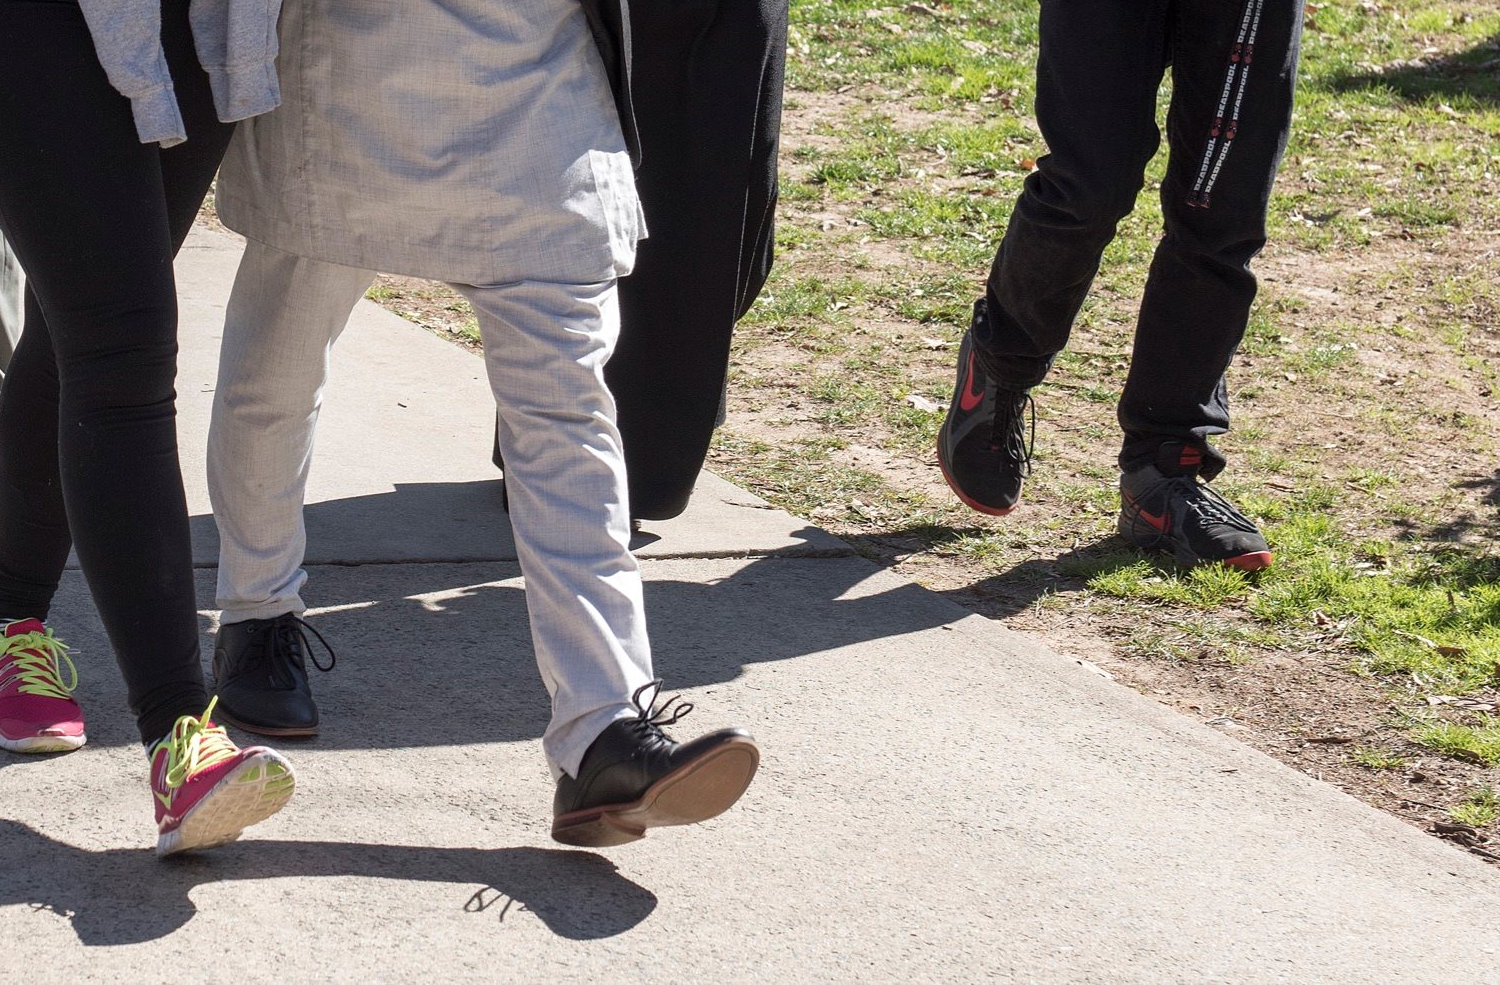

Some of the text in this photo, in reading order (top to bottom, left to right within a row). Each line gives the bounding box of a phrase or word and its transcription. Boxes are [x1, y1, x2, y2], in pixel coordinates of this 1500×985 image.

[1216, 63, 1237, 118] DEADPOOL
[1232, 65, 1250, 121] DEADPOOL
[1193, 137, 1217, 191] DEADPOOL
[1204, 140, 1232, 193] DEADPOOL
